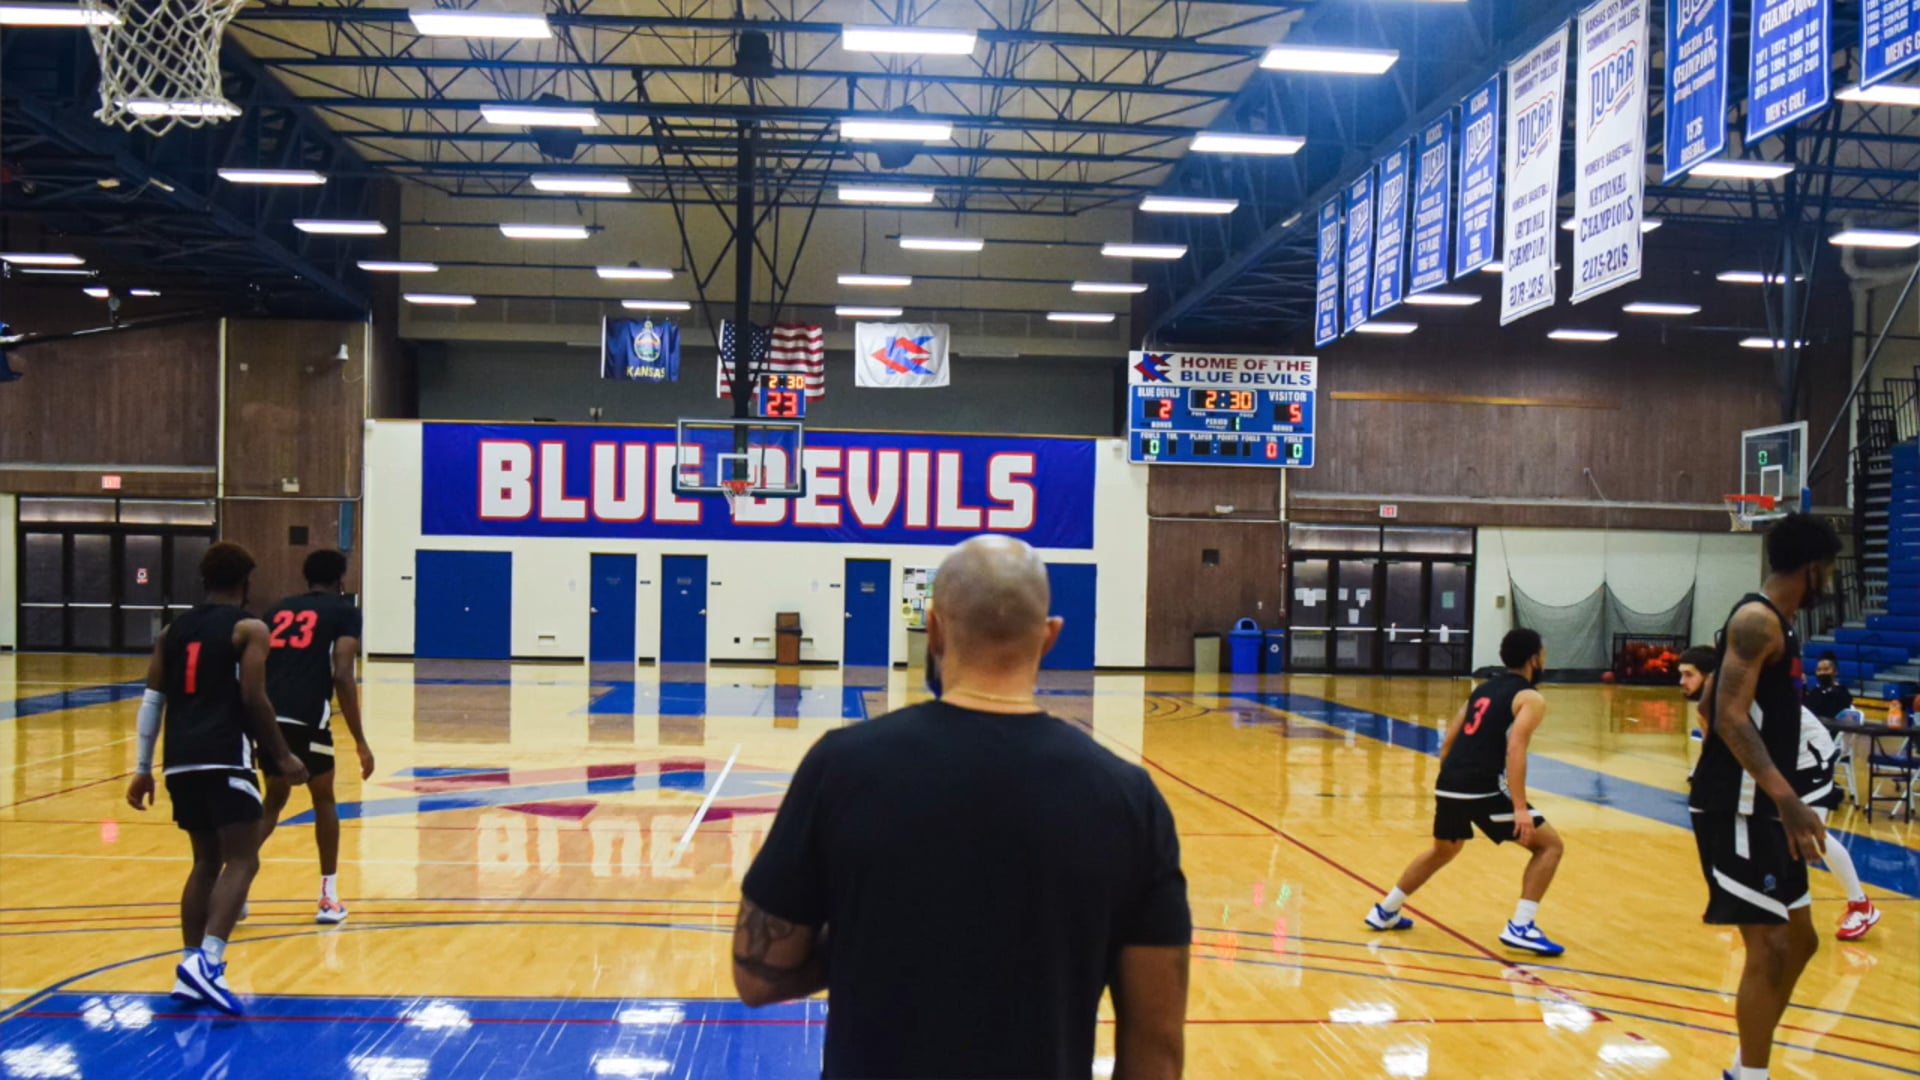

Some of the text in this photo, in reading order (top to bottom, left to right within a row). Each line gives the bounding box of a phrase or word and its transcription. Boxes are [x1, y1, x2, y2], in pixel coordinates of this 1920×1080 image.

[626, 366, 666, 379] KANSAS
[1180, 356, 1312, 372] HOME OF THE
[1181, 371, 1312, 386] BLUE DEVILS
[1156, 387, 1180, 398] DEVILS
[1205, 390, 1252, 410] 2:30
[1269, 391, 1307, 402] VISITOR
[767, 392, 798, 418] 23
[1159, 399, 1172, 419] 2
[1289, 403, 1303, 424] 5
[1150, 440, 1160, 455] 0
[1266, 443, 1278, 460] 0
[1293, 443, 1303, 459] 0
[478, 438, 1038, 533] BLUE DEVILS
[269, 610, 319, 649] 23
[184, 641, 202, 694] 1
[1464, 696, 1491, 736] 3
